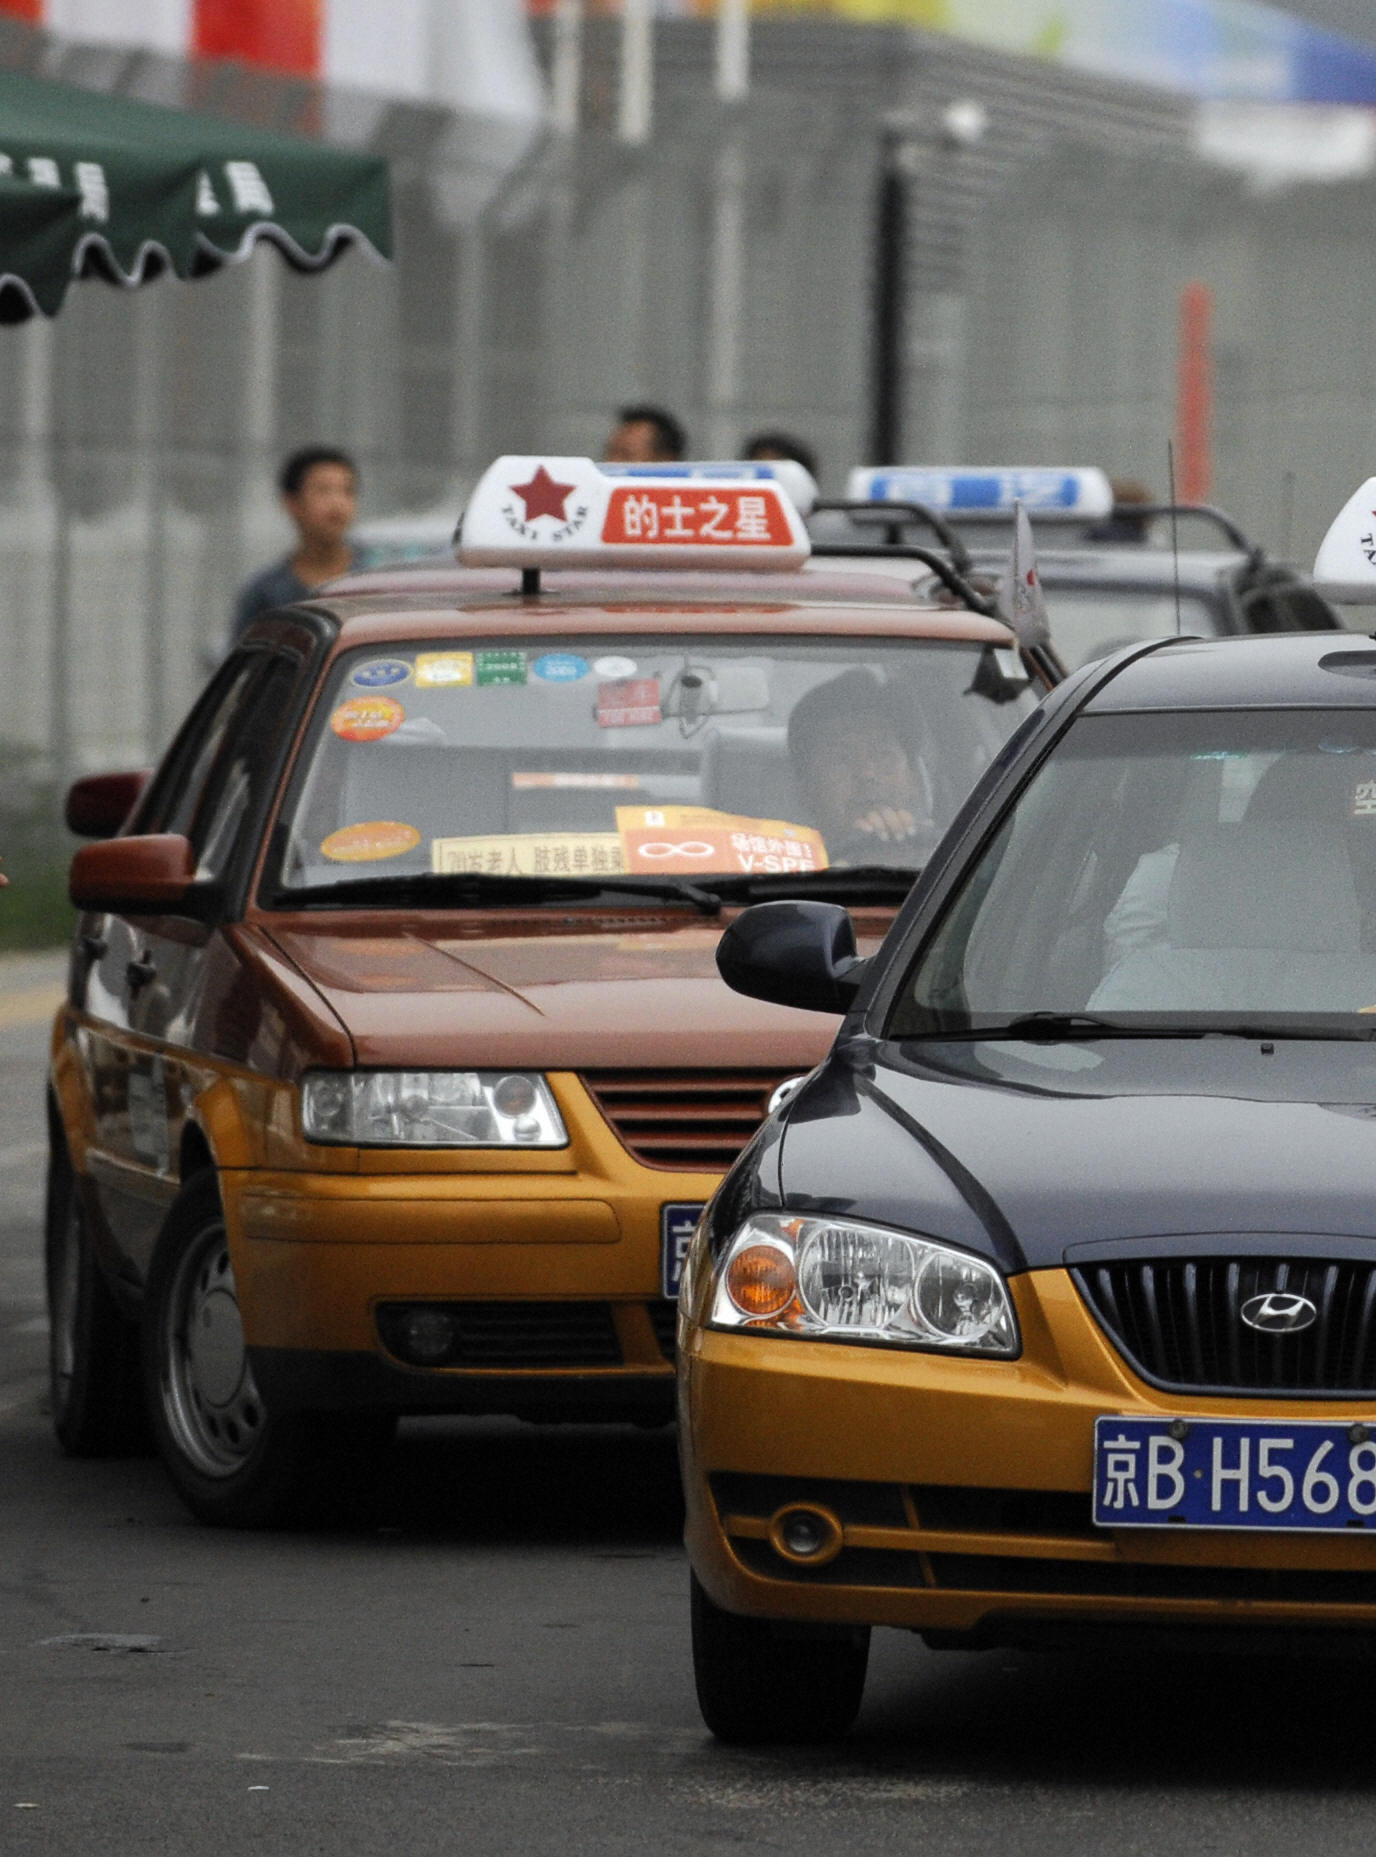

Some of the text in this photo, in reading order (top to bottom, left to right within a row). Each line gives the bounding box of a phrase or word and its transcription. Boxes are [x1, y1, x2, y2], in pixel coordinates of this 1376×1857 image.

[502, 504, 589, 542] TAXI STAR
[624, 495, 771, 540] 的士之星
